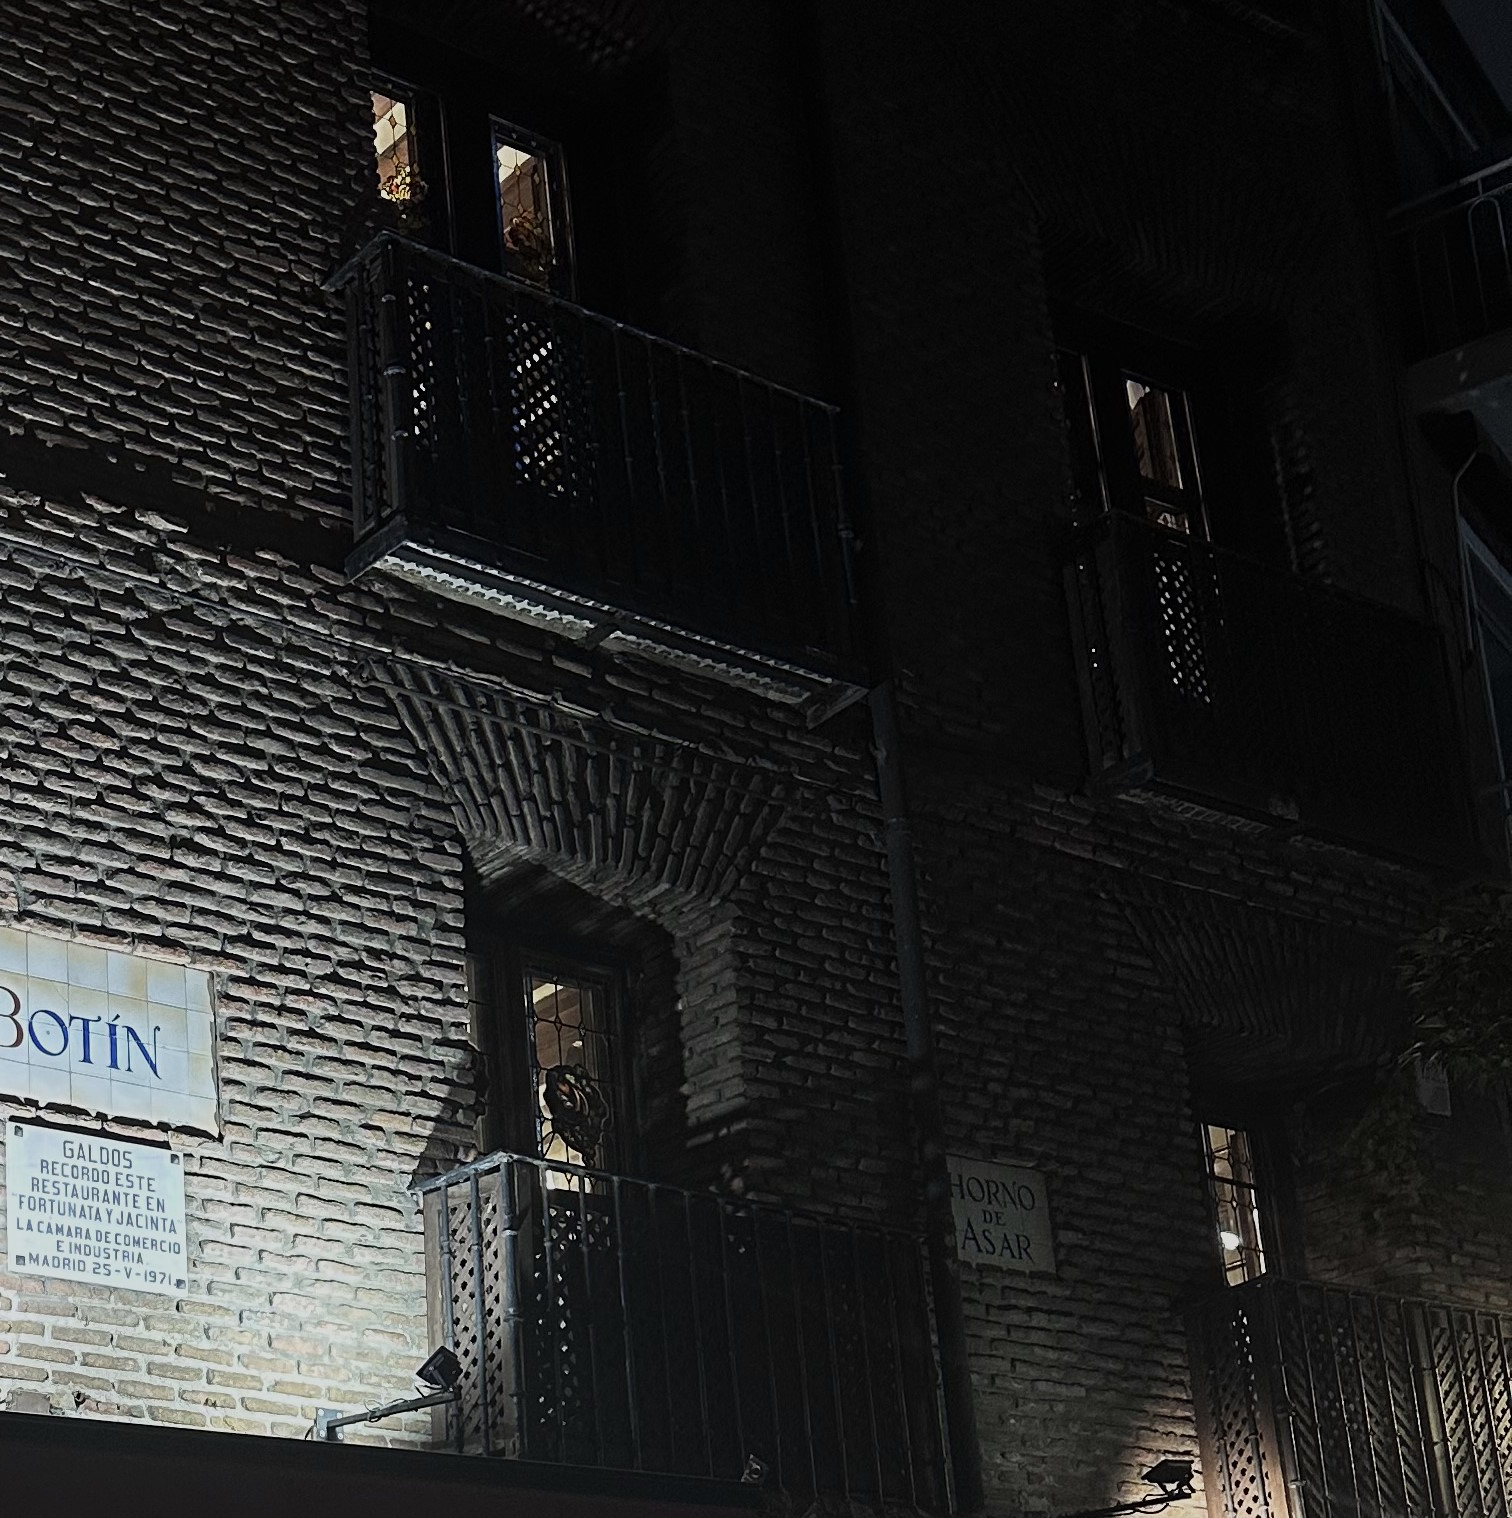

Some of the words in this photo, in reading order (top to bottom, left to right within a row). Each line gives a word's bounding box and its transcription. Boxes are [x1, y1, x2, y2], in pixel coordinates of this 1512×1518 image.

[63, 1140, 133, 1169] GALDOS
[40, 1159, 110, 1185] RECORDO
[115, 1172, 156, 1192] ESTE
[31, 1177, 144, 1210] RESTAURANTE
[146, 1196, 166, 1213] EN
[951, 1174, 1036, 1211] HORNO
[106, 1207, 114, 1224] Y
[981, 1208, 1006, 1226] DE
[16, 1217, 34, 1232] LA
[37, 1220, 92, 1240] CAMARA
[95, 1230, 114, 1243] DE
[114, 1234, 181, 1255] COMERCIO
[961, 1218, 1036, 1264] ASAR
[28, 1252, 86, 1273] MADRID
[56, 1239, 65, 1252] E
[68, 1243, 144, 1265] INDUSTRIA
